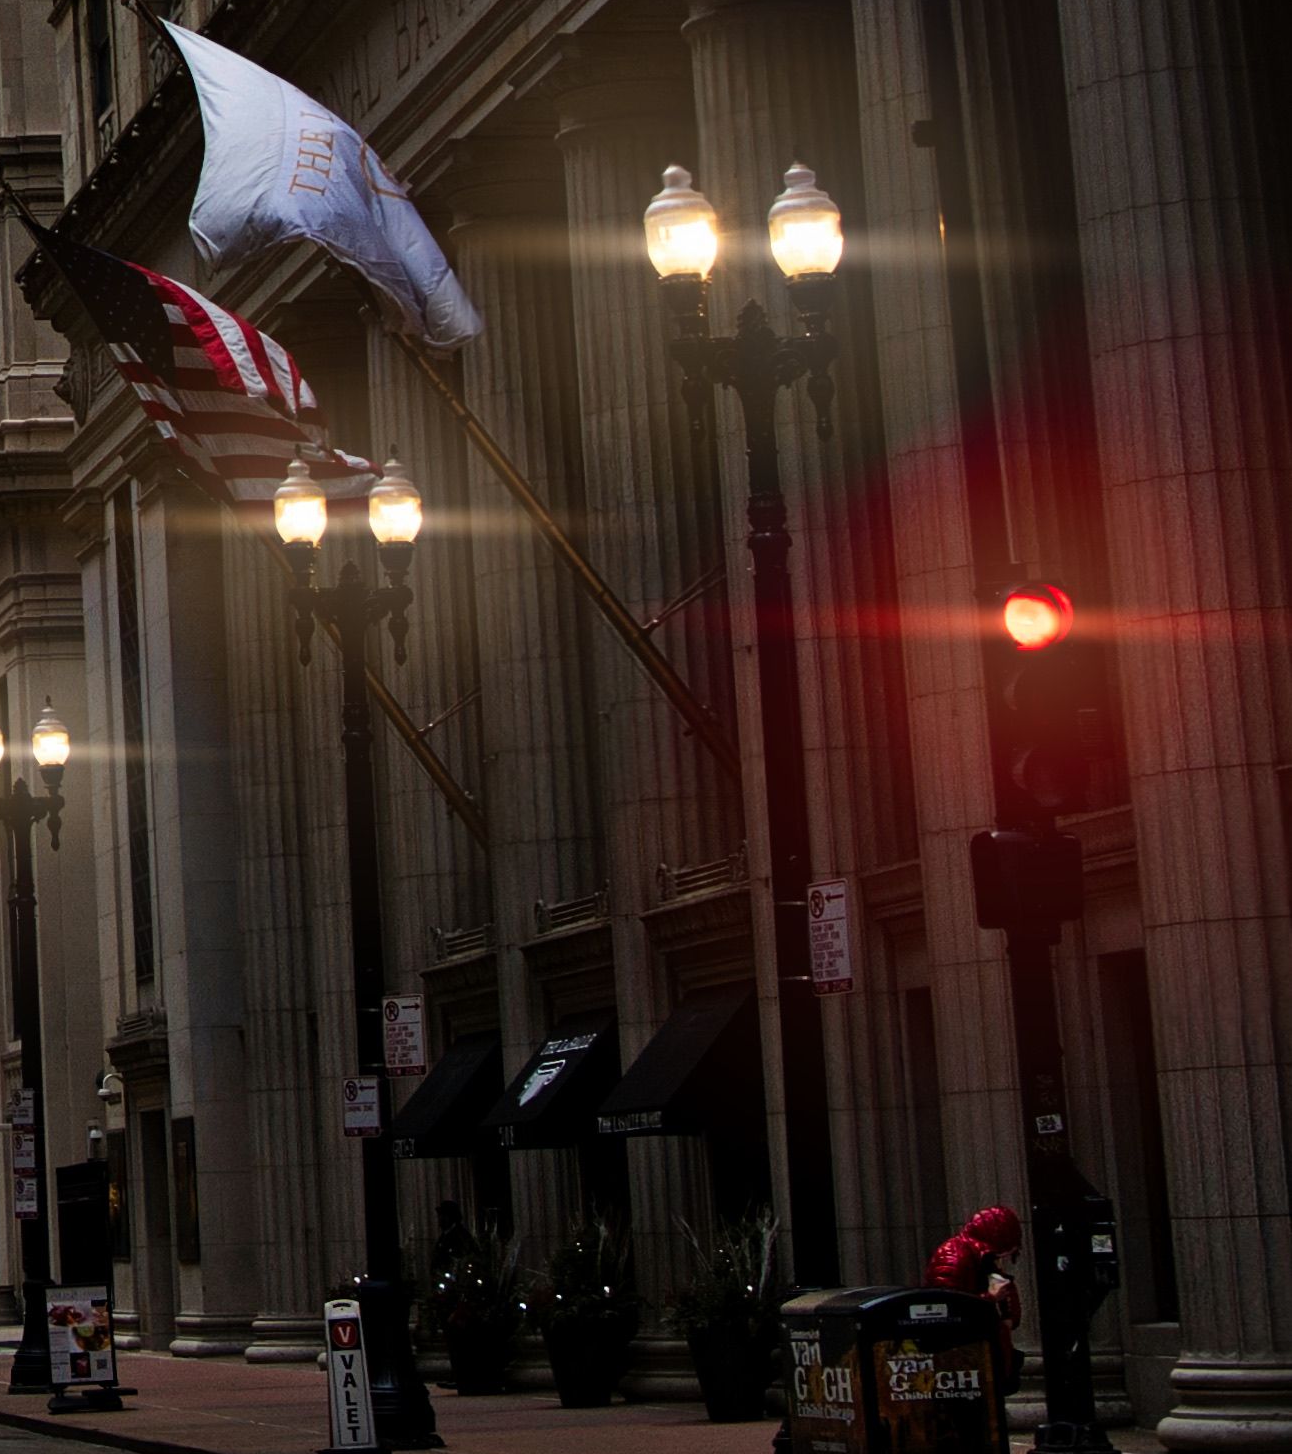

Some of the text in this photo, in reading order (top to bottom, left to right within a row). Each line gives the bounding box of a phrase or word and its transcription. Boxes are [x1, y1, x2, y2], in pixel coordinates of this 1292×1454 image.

[289, 127, 334, 196] THE
[337, 1326, 352, 1344] V
[790, 1341, 822, 1367] van
[887, 1358, 935, 1374] van
[794, 1366, 853, 1403] GGH
[889, 1369, 981, 1393] GGH
[339, 1354, 361, 1442] VALET
[890, 1390, 983, 1401] Exhibit Chicago
